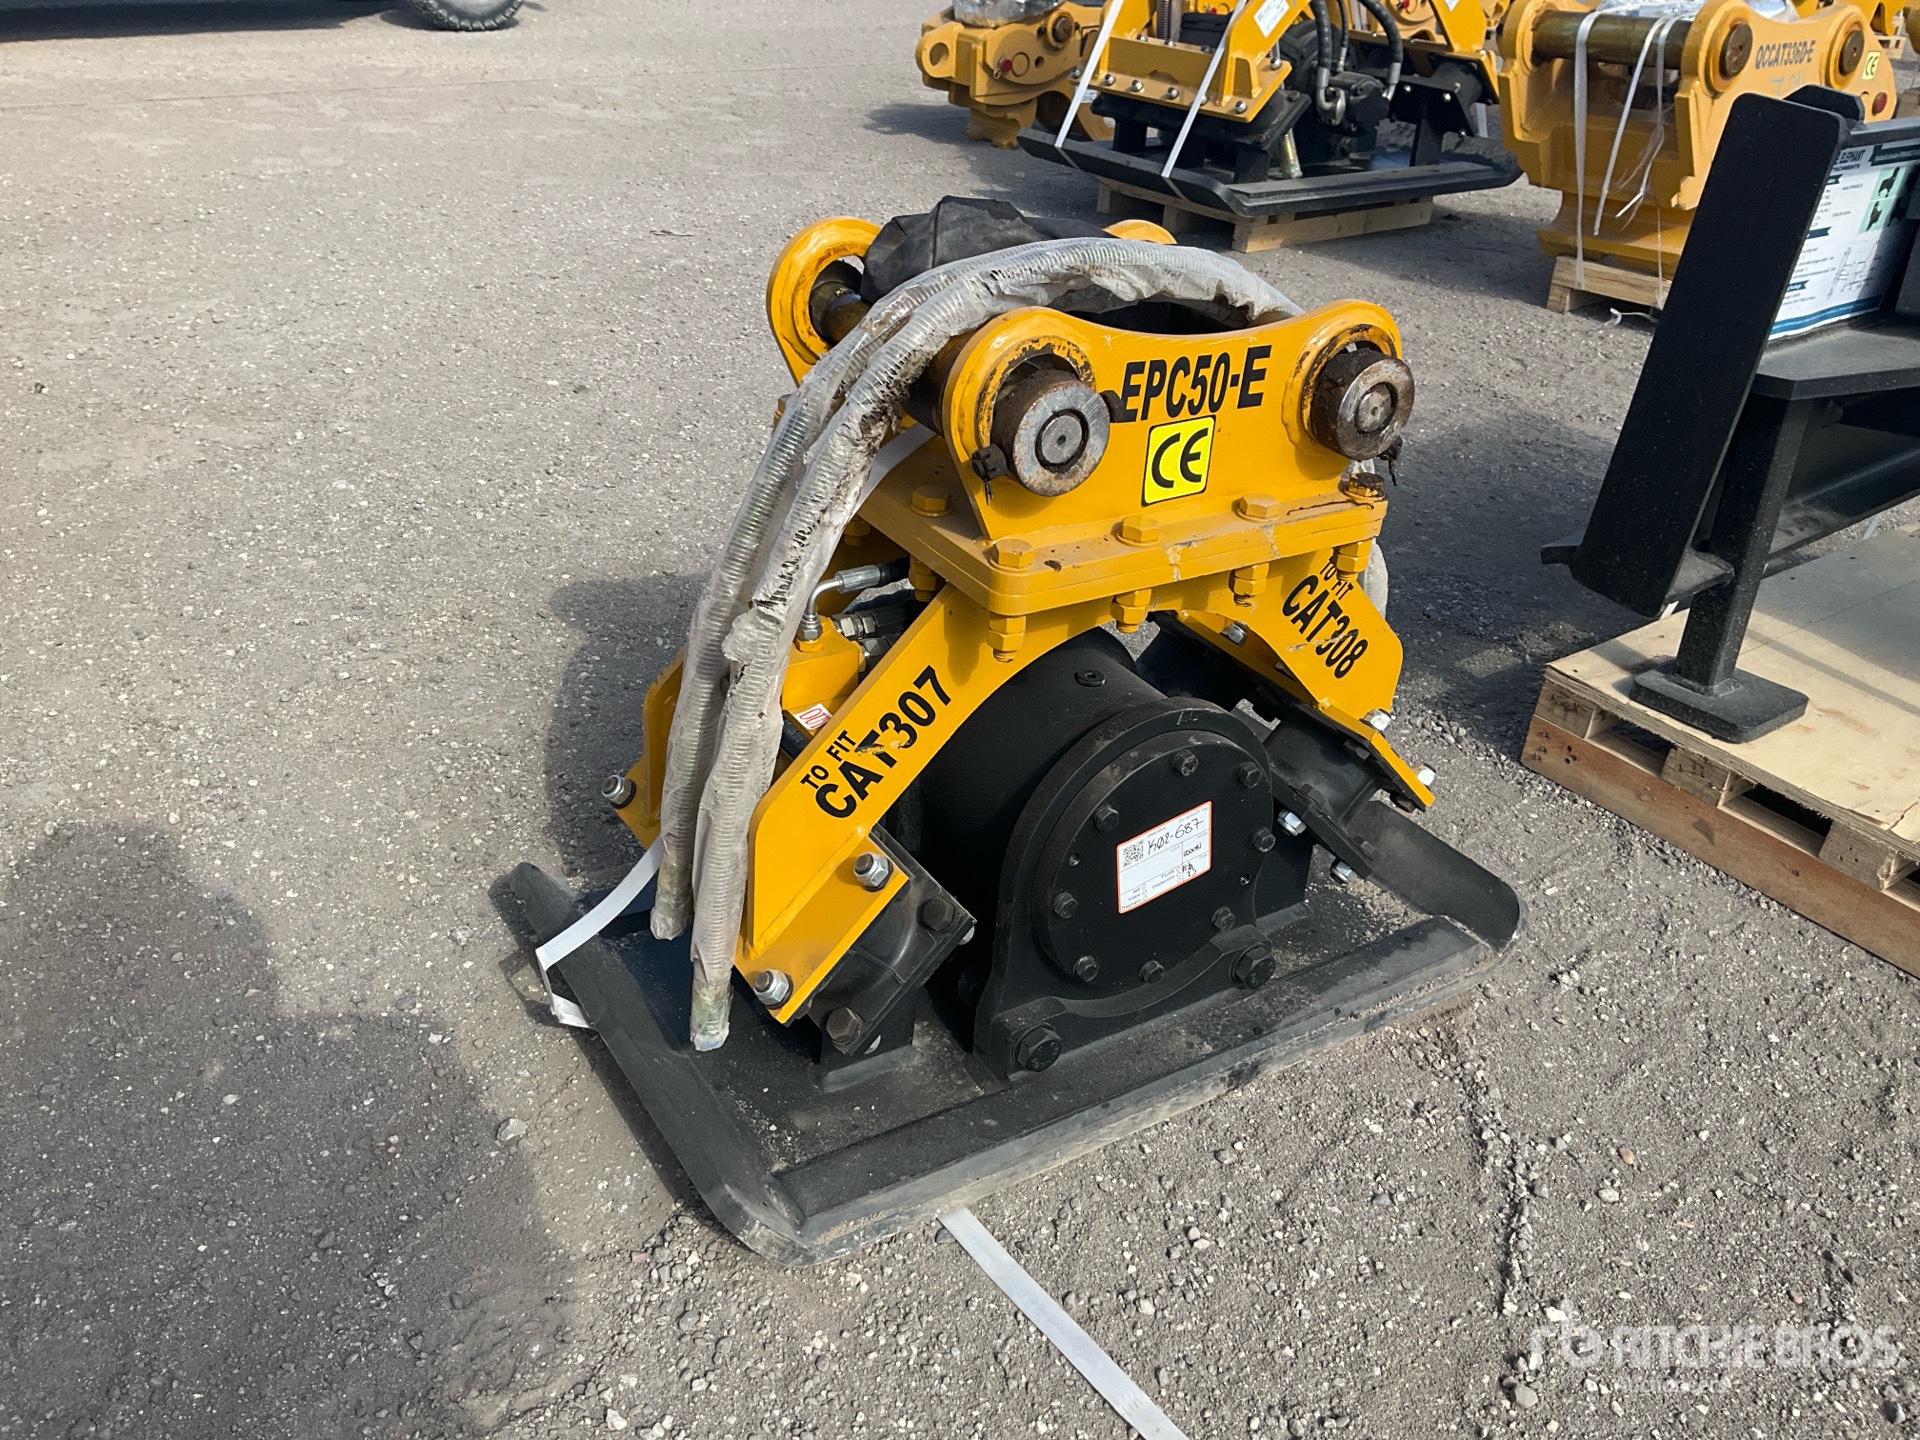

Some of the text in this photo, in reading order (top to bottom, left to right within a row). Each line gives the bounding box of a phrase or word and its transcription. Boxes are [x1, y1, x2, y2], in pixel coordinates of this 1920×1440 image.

[1866, 55, 1879, 76] CE
[1833, 163, 1861, 172] TACHMENTS
[1121, 345, 1272, 422] EPC50-E
[1151, 427, 1209, 489] CE
[1282, 575, 1368, 679] CAT308
[800, 730, 856, 789] TO FIT
[815, 665, 951, 818] CAT307
